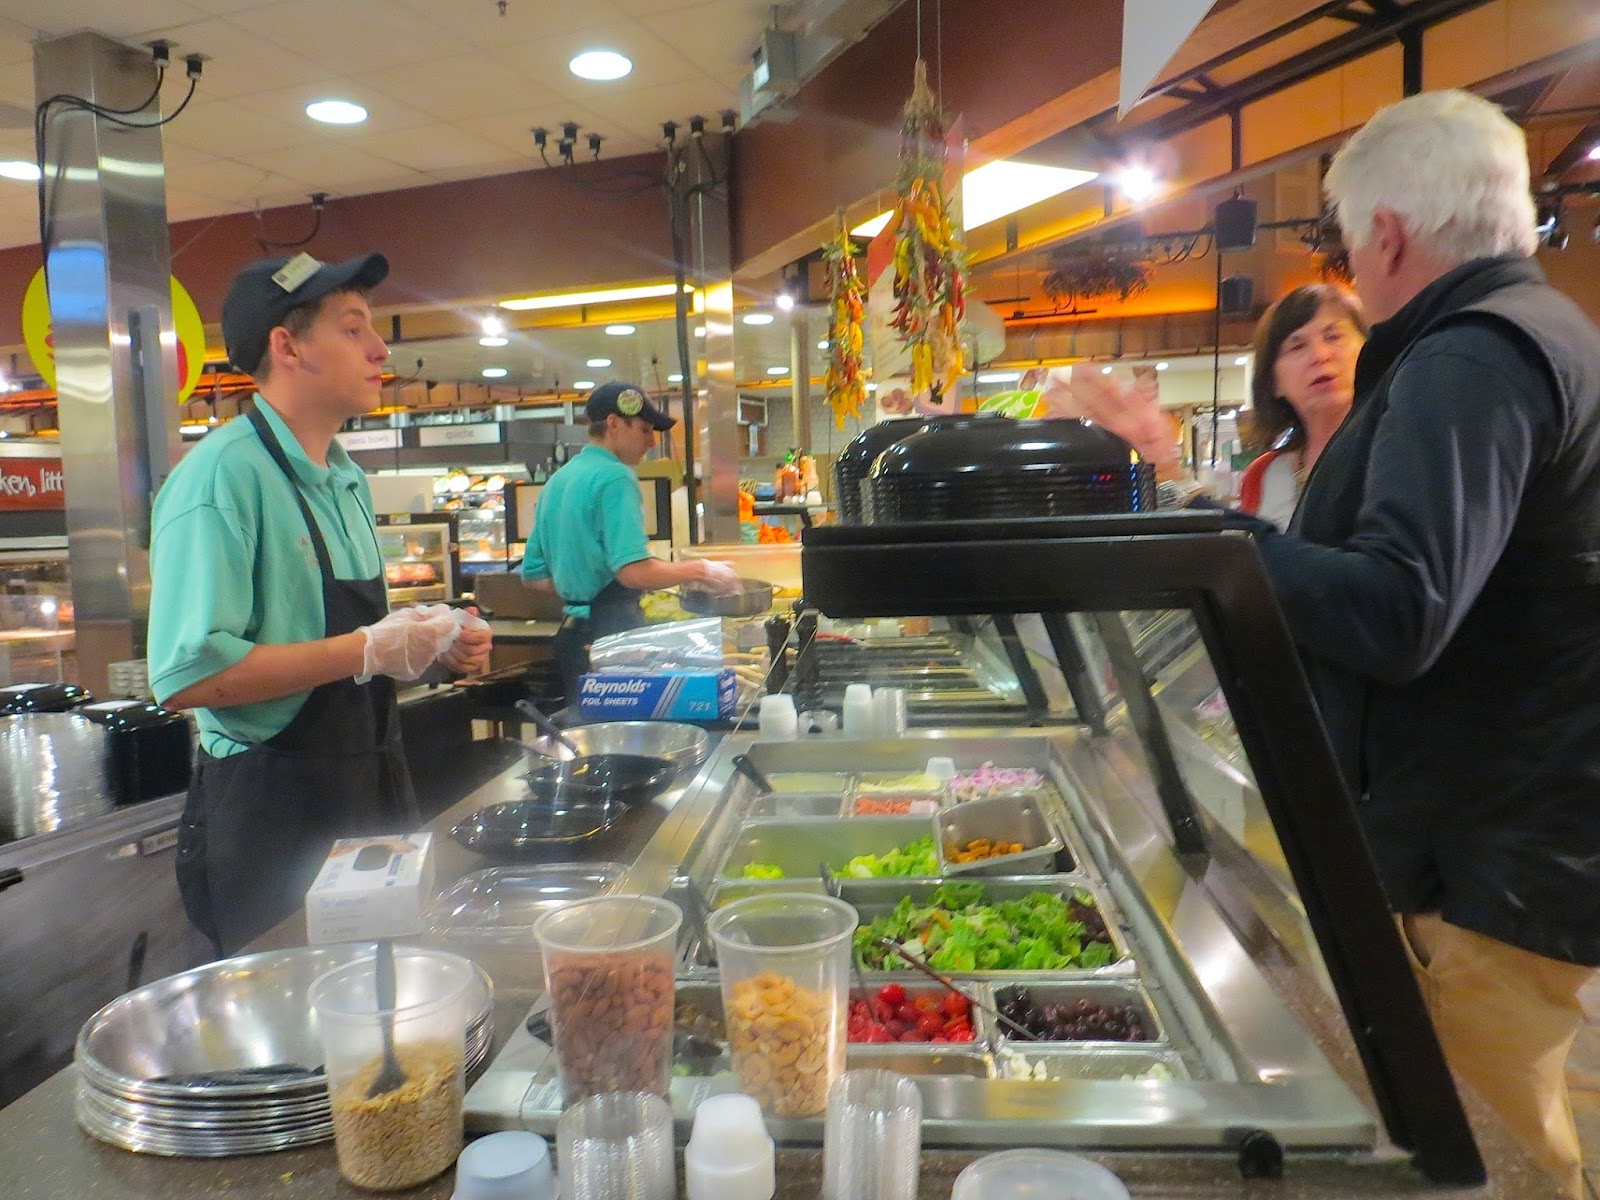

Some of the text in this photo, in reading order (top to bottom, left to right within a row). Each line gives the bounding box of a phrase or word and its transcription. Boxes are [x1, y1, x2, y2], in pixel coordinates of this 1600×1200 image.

[582, 678, 647, 697] Reynolds
[582, 697, 638, 707] FOIL SHEETS
